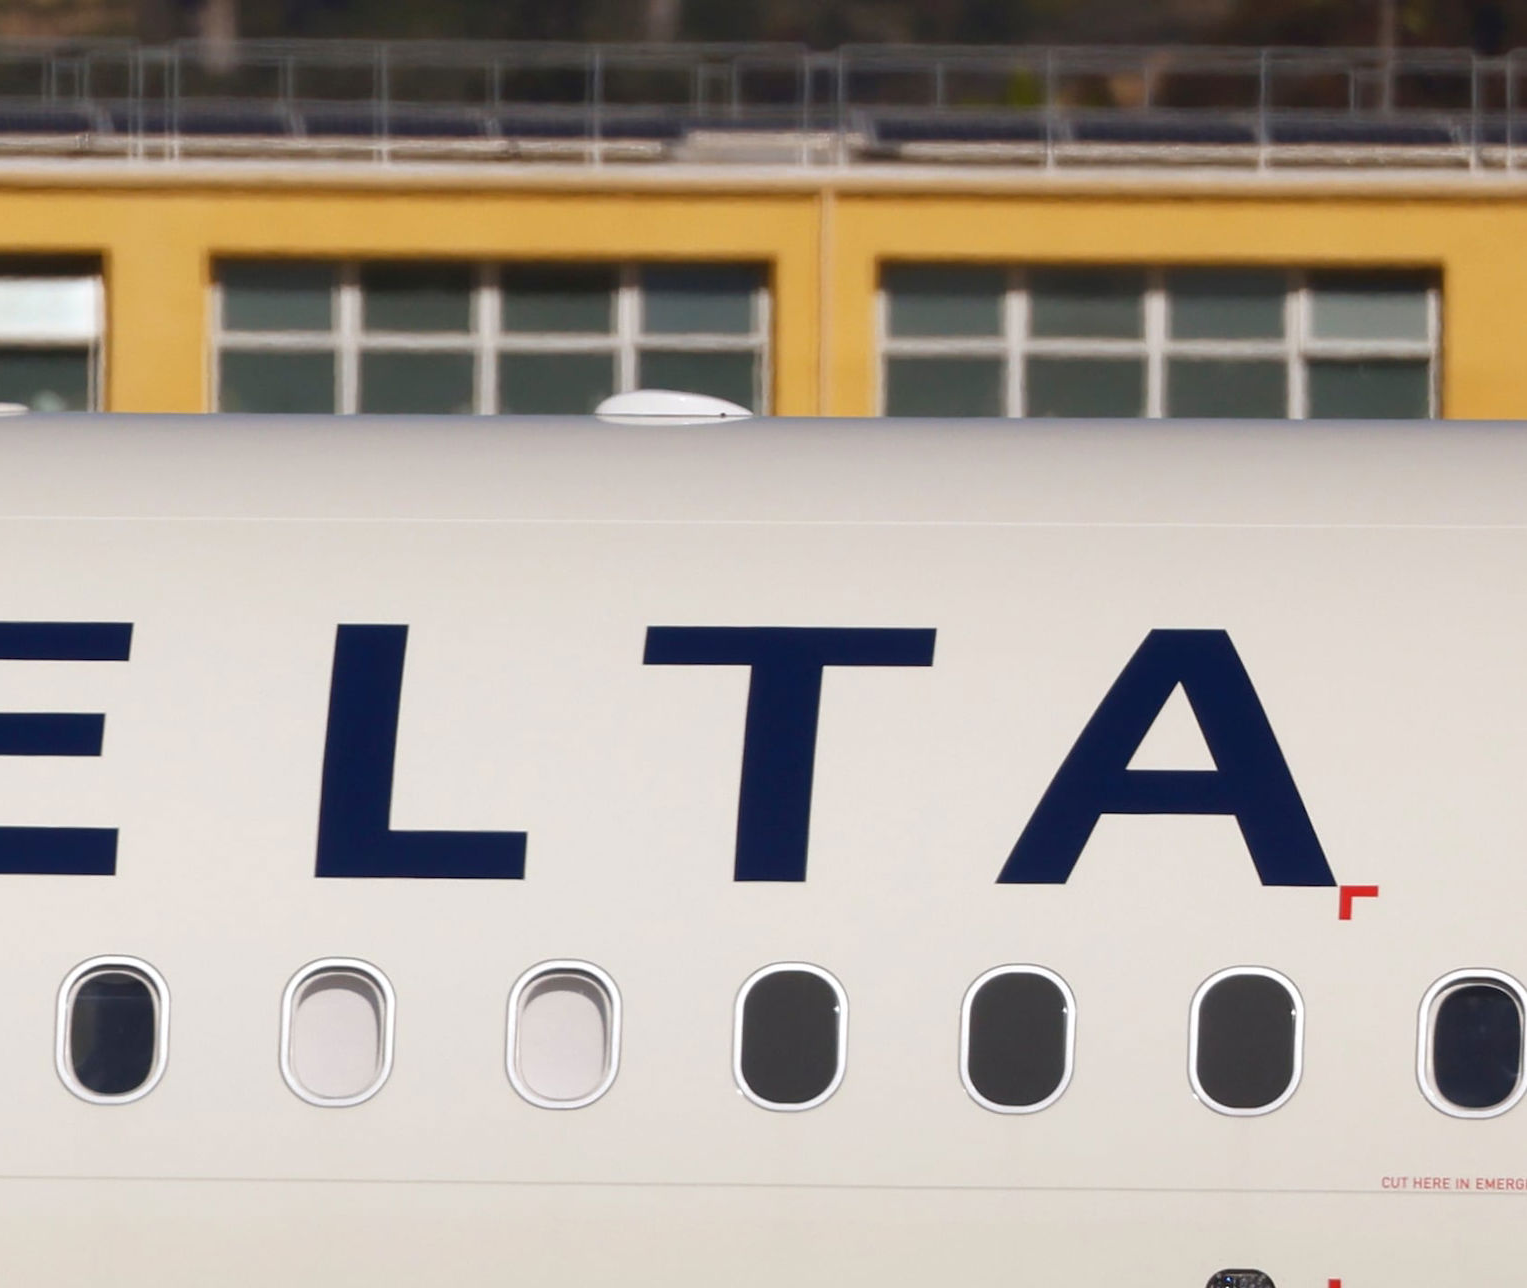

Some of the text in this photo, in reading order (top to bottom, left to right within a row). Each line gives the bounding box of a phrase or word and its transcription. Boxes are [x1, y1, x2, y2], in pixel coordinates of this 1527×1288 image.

[1381, 1176, 1527, 1191] CUT HERE IN EMERG
